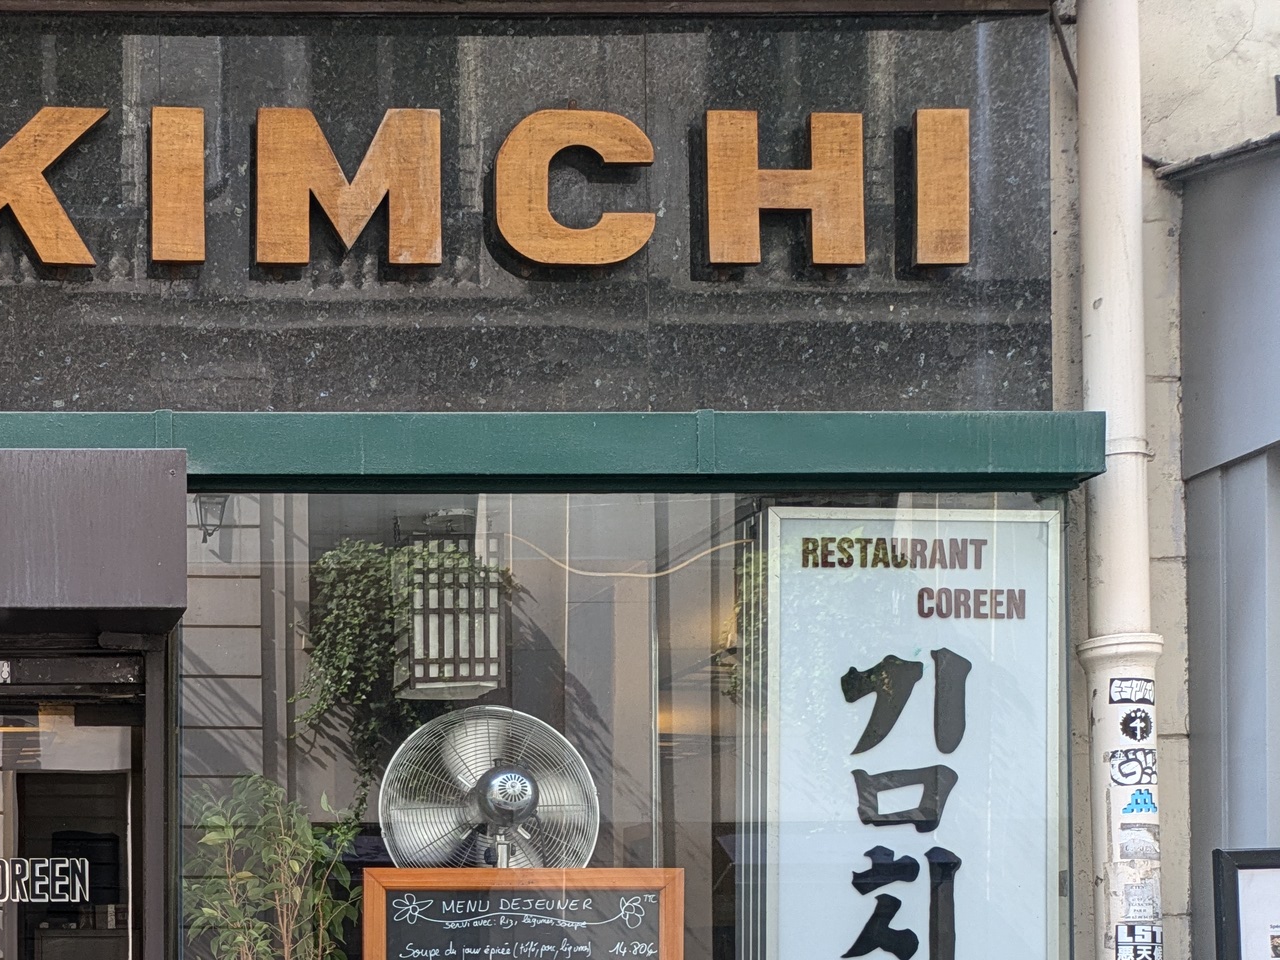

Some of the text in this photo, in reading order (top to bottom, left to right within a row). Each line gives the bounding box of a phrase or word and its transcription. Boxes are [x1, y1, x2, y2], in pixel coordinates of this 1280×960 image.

[802, 537, 988, 569] RESTAURANT
[918, 588, 1026, 620] COREEN
[441, 899, 490, 914] MENU
[499, 898, 593, 911] DEJEUNER
[444, 941, 457, 956] du
